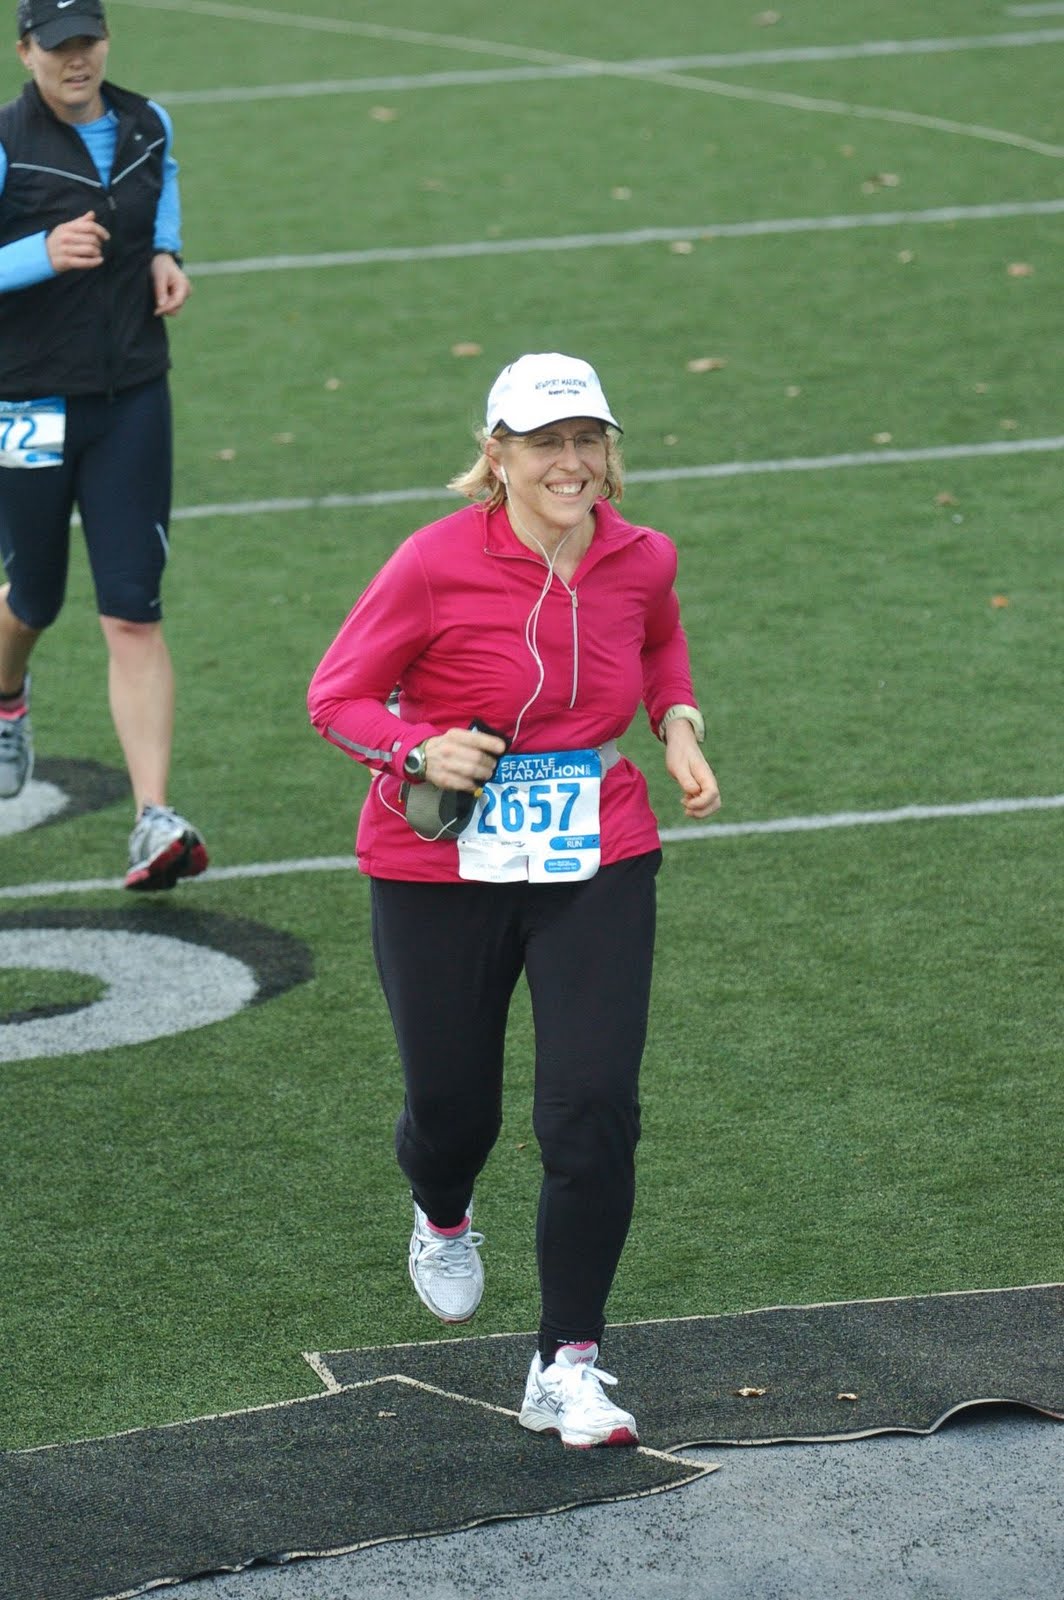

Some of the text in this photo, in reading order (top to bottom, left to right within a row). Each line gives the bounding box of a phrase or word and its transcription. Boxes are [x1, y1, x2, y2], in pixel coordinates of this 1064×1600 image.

[501, 758, 555, 772] SEATTLE
[501, 765, 584, 782] MARATHON
[477, 782, 580, 834] 2657
[566, 840, 583, 848] RUN
